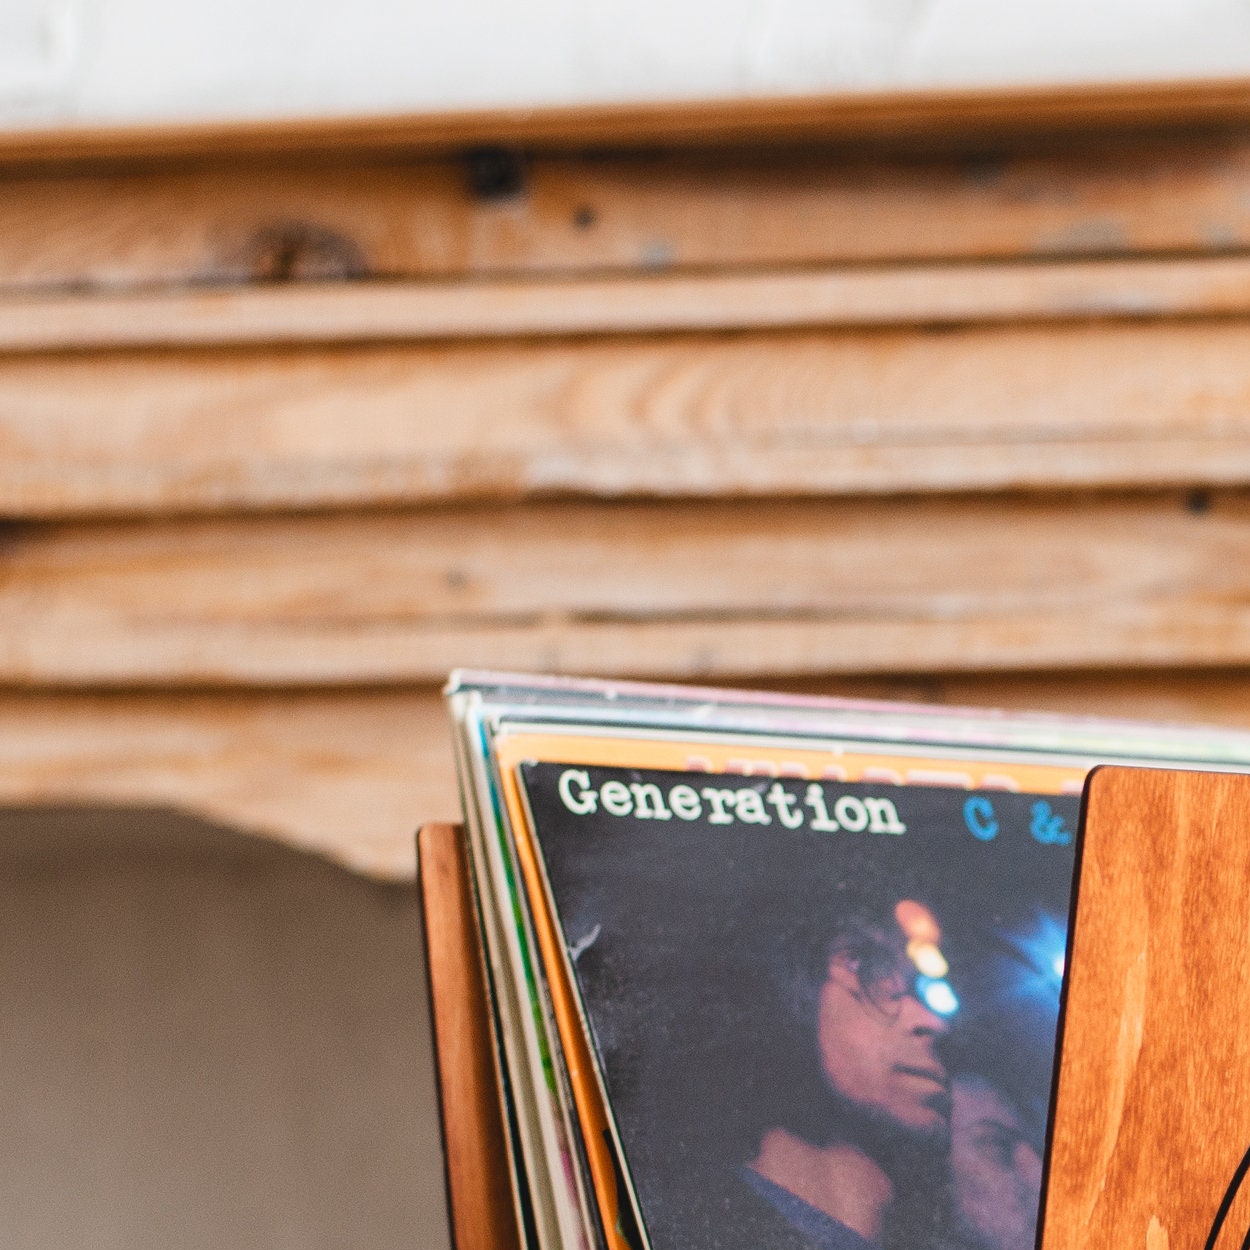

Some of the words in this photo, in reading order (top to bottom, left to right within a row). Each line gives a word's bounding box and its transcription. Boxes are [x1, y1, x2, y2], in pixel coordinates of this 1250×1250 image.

[557, 768, 907, 835] Generation
[961, 796, 1000, 843] C
[1029, 800, 1073, 846] &
